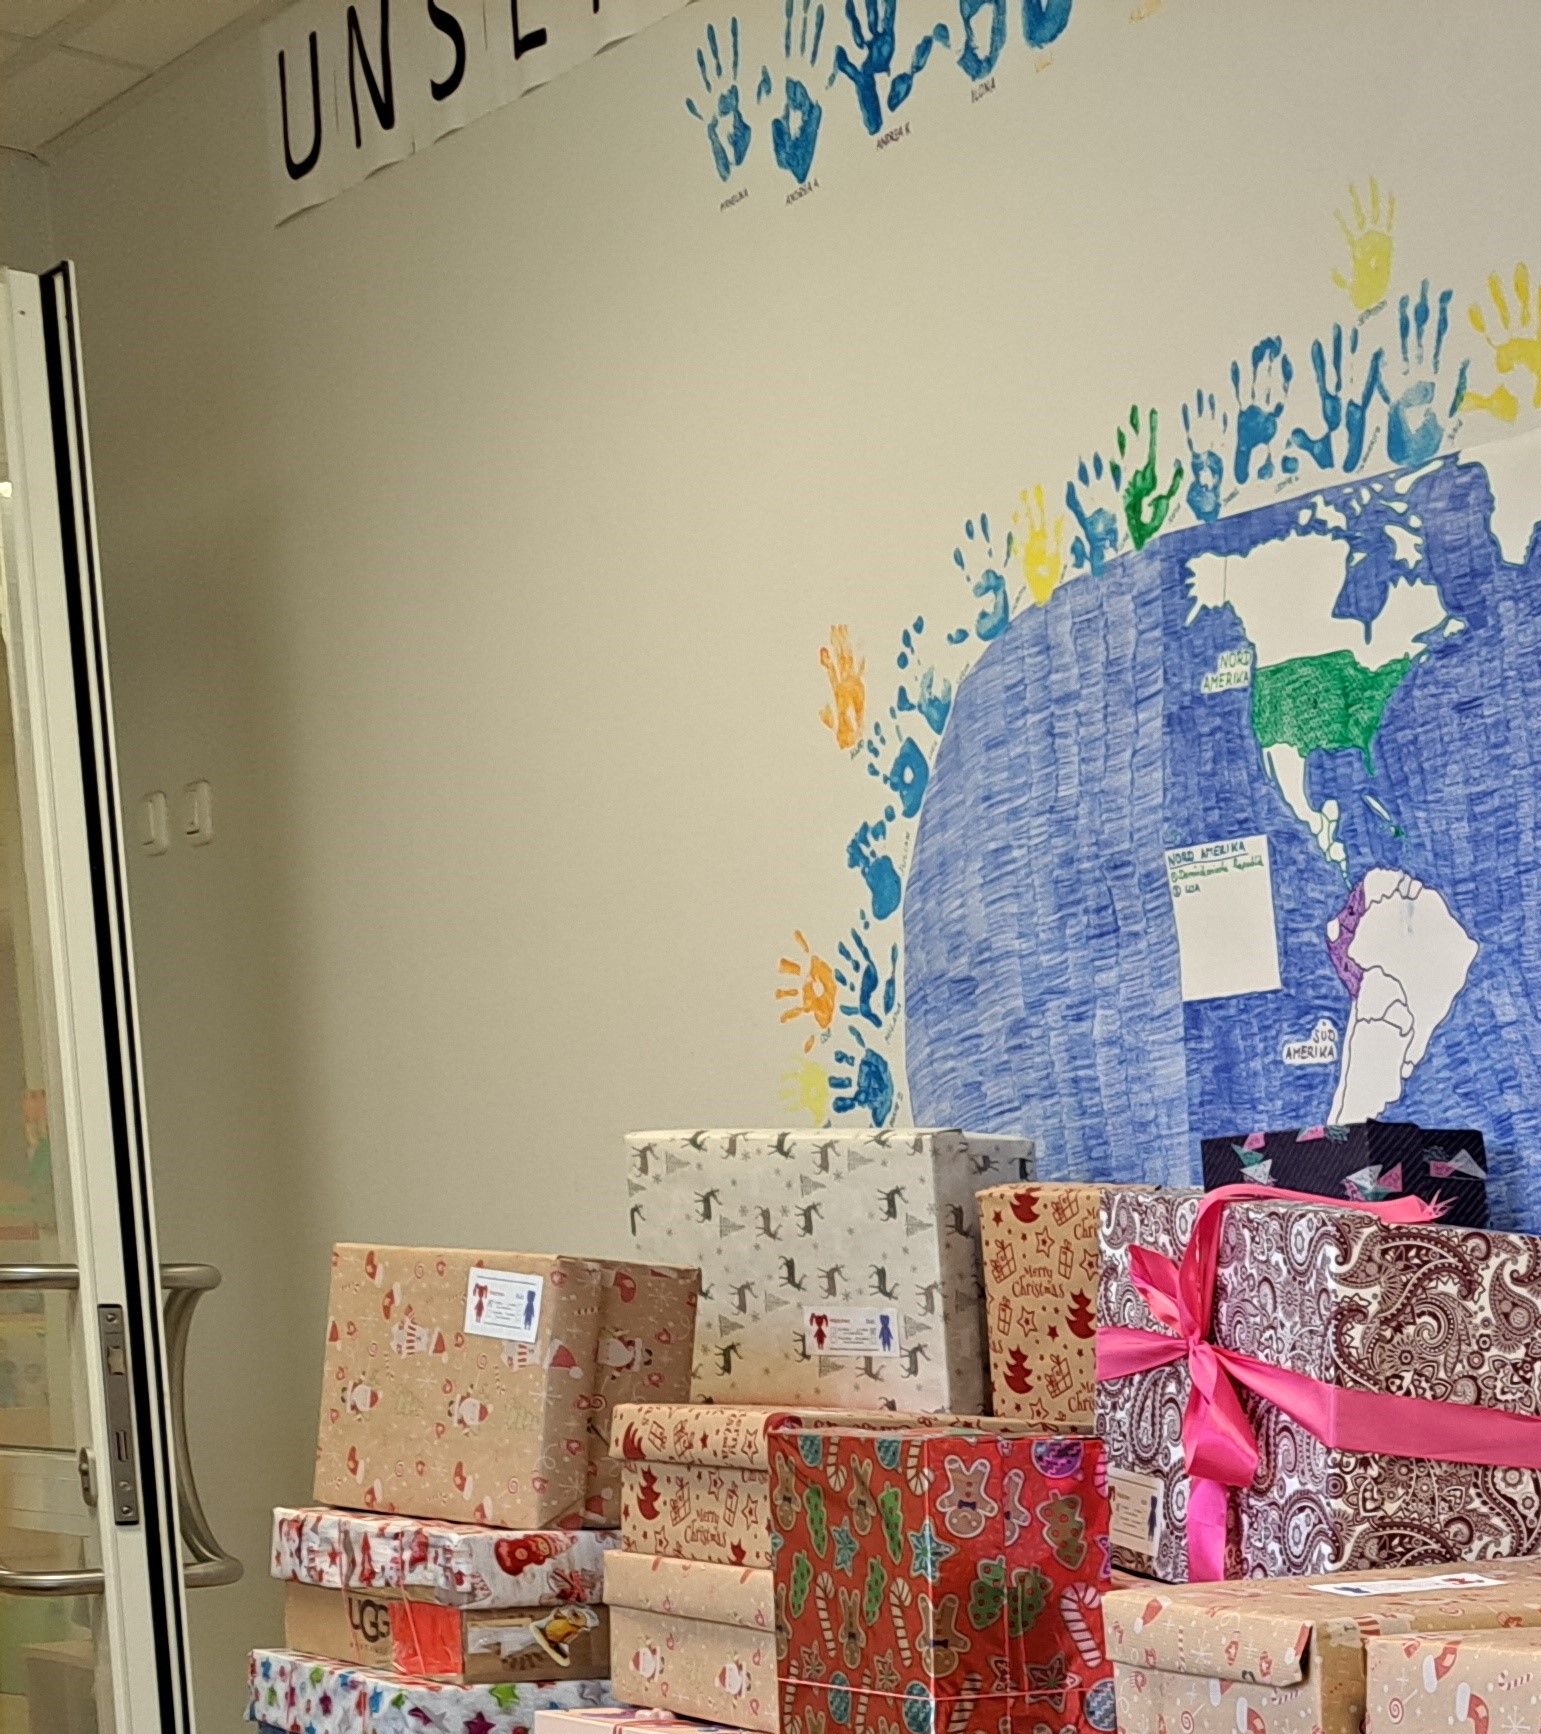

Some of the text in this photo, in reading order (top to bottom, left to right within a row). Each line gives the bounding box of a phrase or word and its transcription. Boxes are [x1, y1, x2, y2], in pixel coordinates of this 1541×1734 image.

[1220, 650, 1250, 668] NORD
[1203, 671, 1249, 692] AMERIKA
[1167, 840, 1246, 866] NORD AMERIKA
[1286, 1045, 1335, 1060] AMERIKA
[1024, 1264, 1053, 1281] Merry
[1011, 1277, 1065, 1299] Christmas
